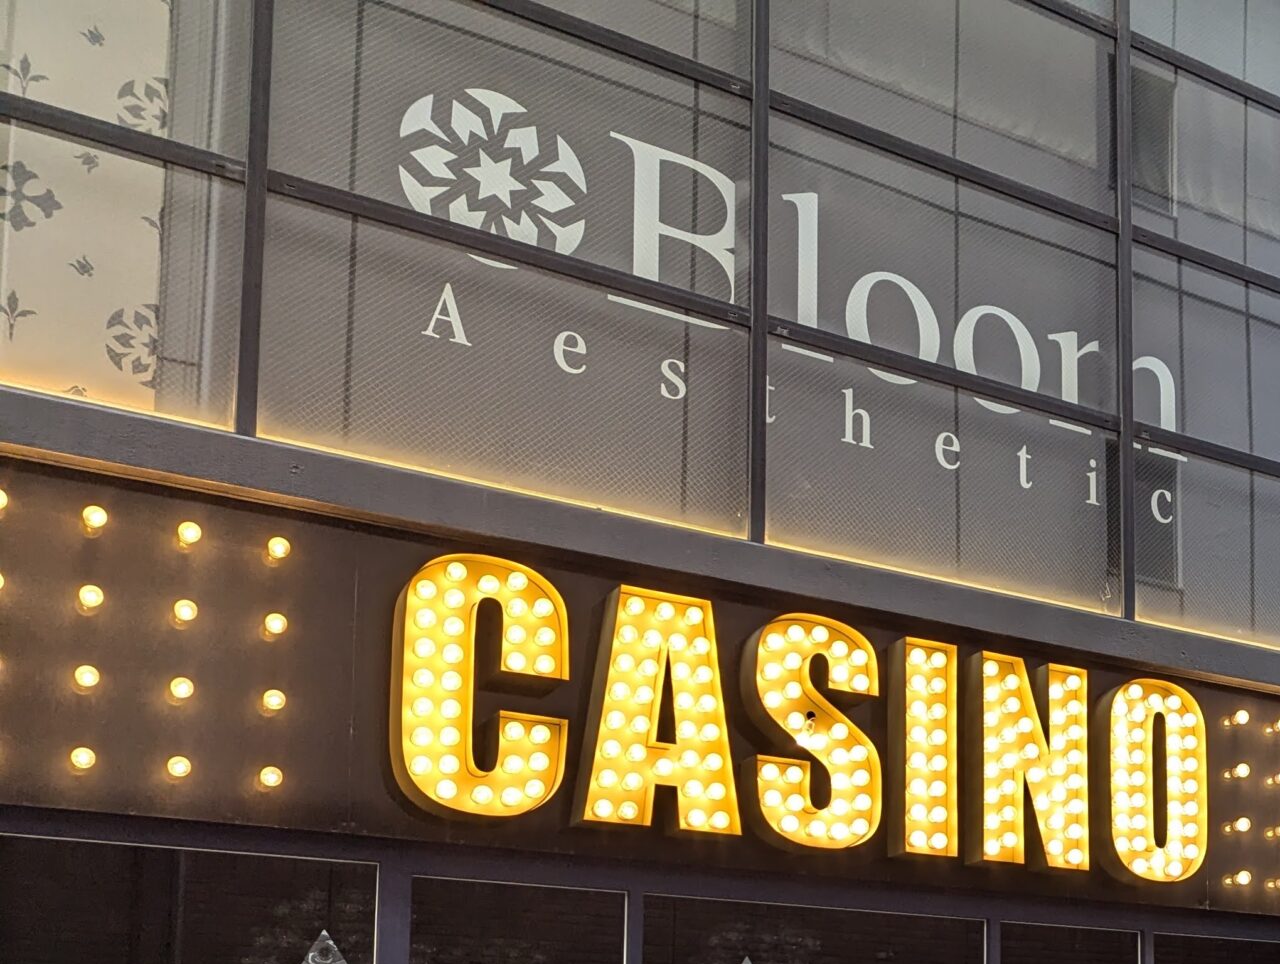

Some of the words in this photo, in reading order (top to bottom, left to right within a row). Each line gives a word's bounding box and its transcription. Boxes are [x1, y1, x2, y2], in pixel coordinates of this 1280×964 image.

[422, 283, 1172, 524] Aesthetic
[610, 131, 1187, 461] Bloom
[391, 553, 1208, 883] CASINO
